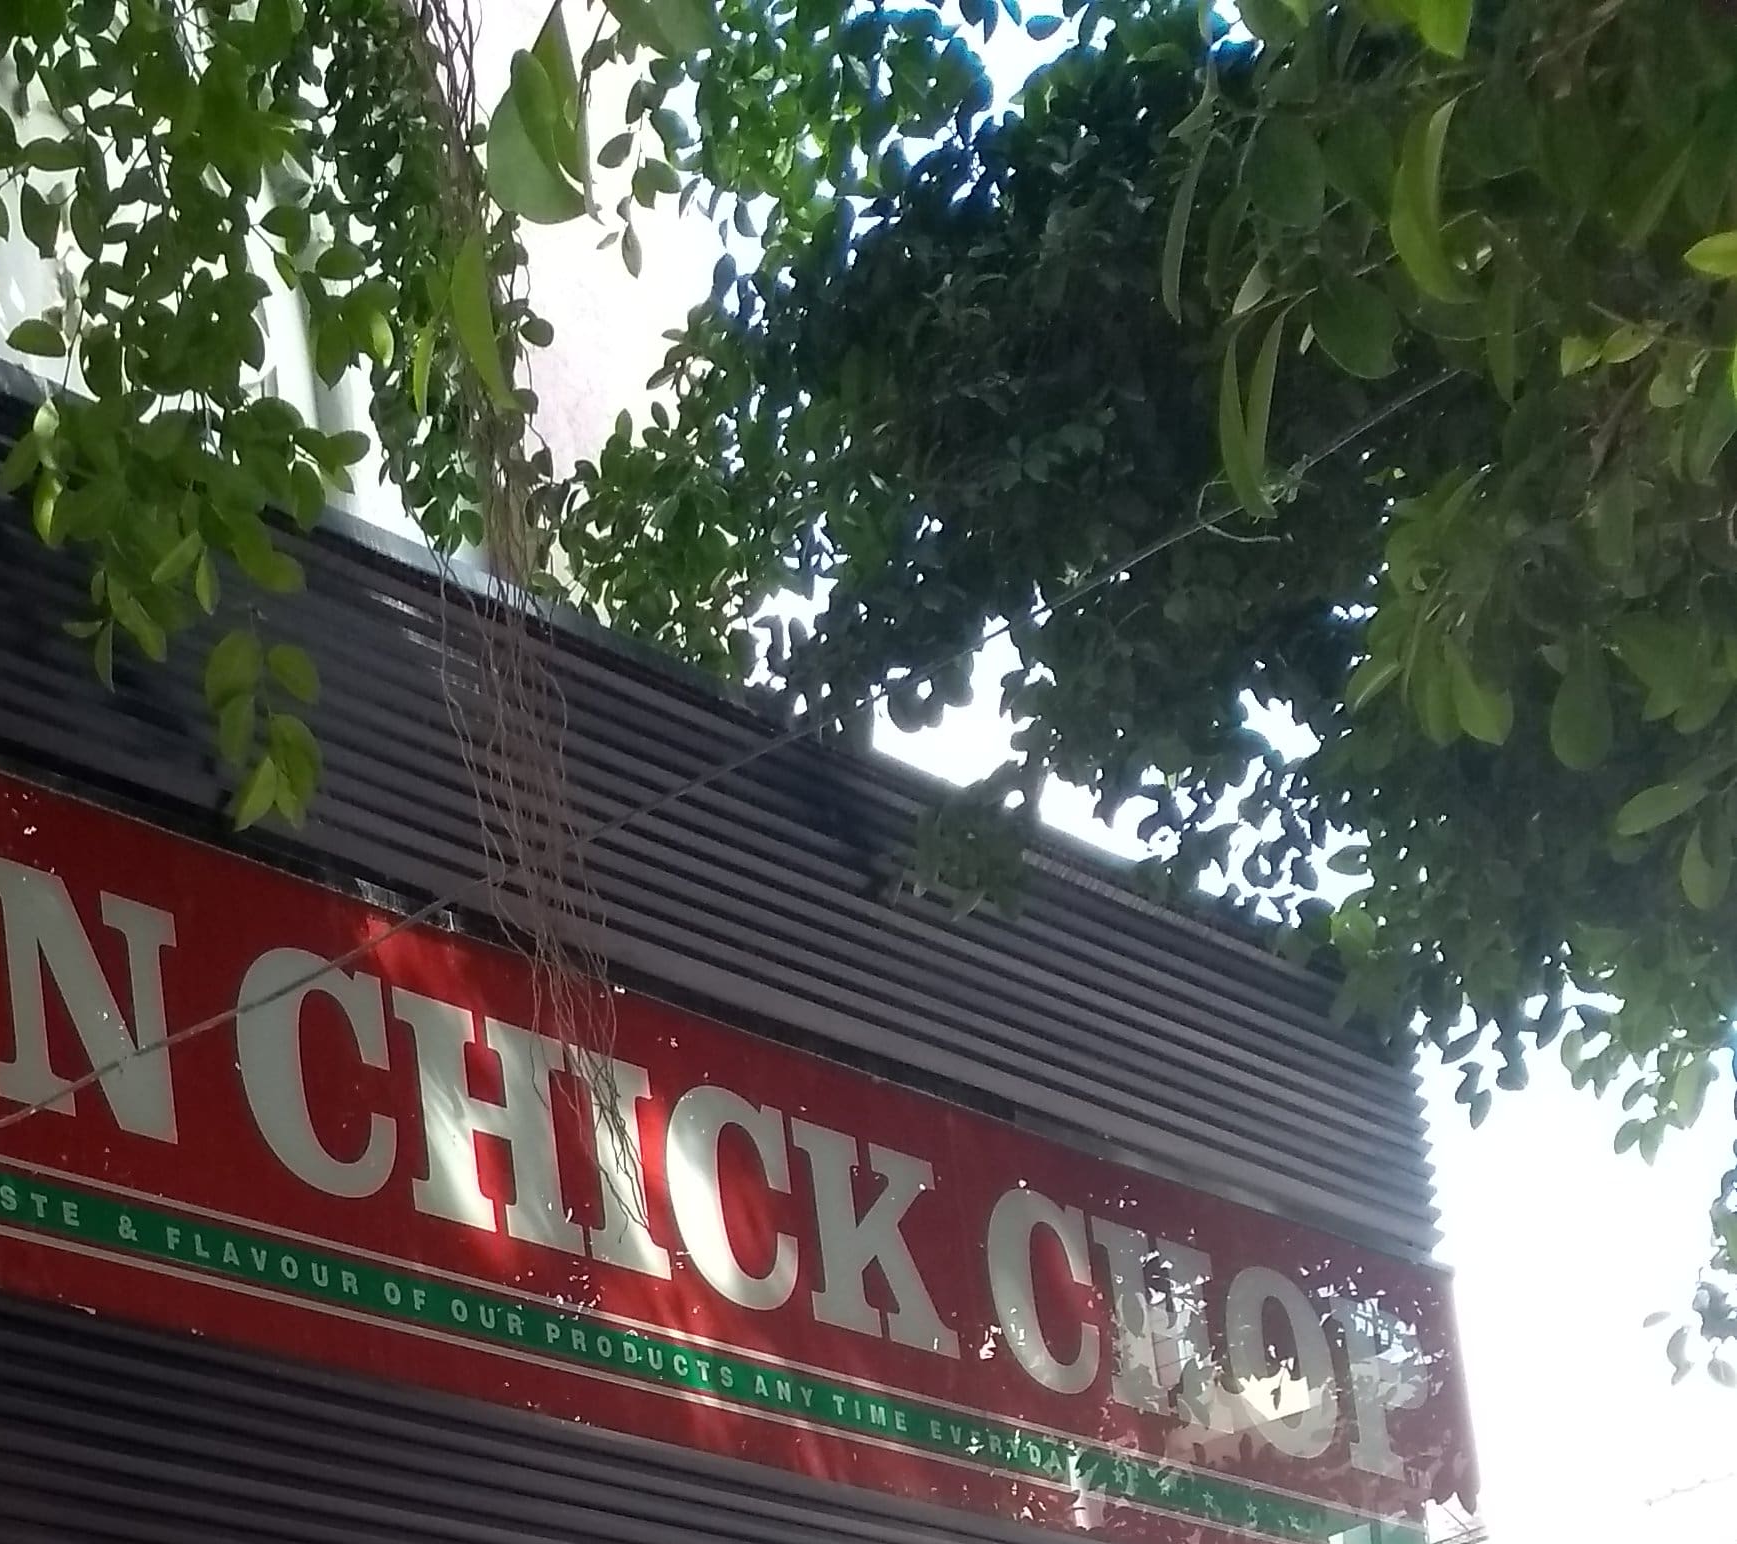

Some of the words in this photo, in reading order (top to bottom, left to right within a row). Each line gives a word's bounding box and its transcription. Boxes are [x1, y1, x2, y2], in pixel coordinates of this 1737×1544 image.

[119, 1215, 138, 1242] &
[167, 1227, 358, 1297] FLAVOUR
[385, 1281, 426, 1311] OF
[451, 1298, 523, 1337] OUR
[546, 1322, 734, 1389] PRODUCTS
[754, 1375, 814, 1408] ANY
[832, 1394, 907, 1433] TIME
[930, 1419, 1081, 1480] EVERYDA
[236, 946, 960, 1359] CHICK
[987, 1187, 1429, 1481] CHOP
